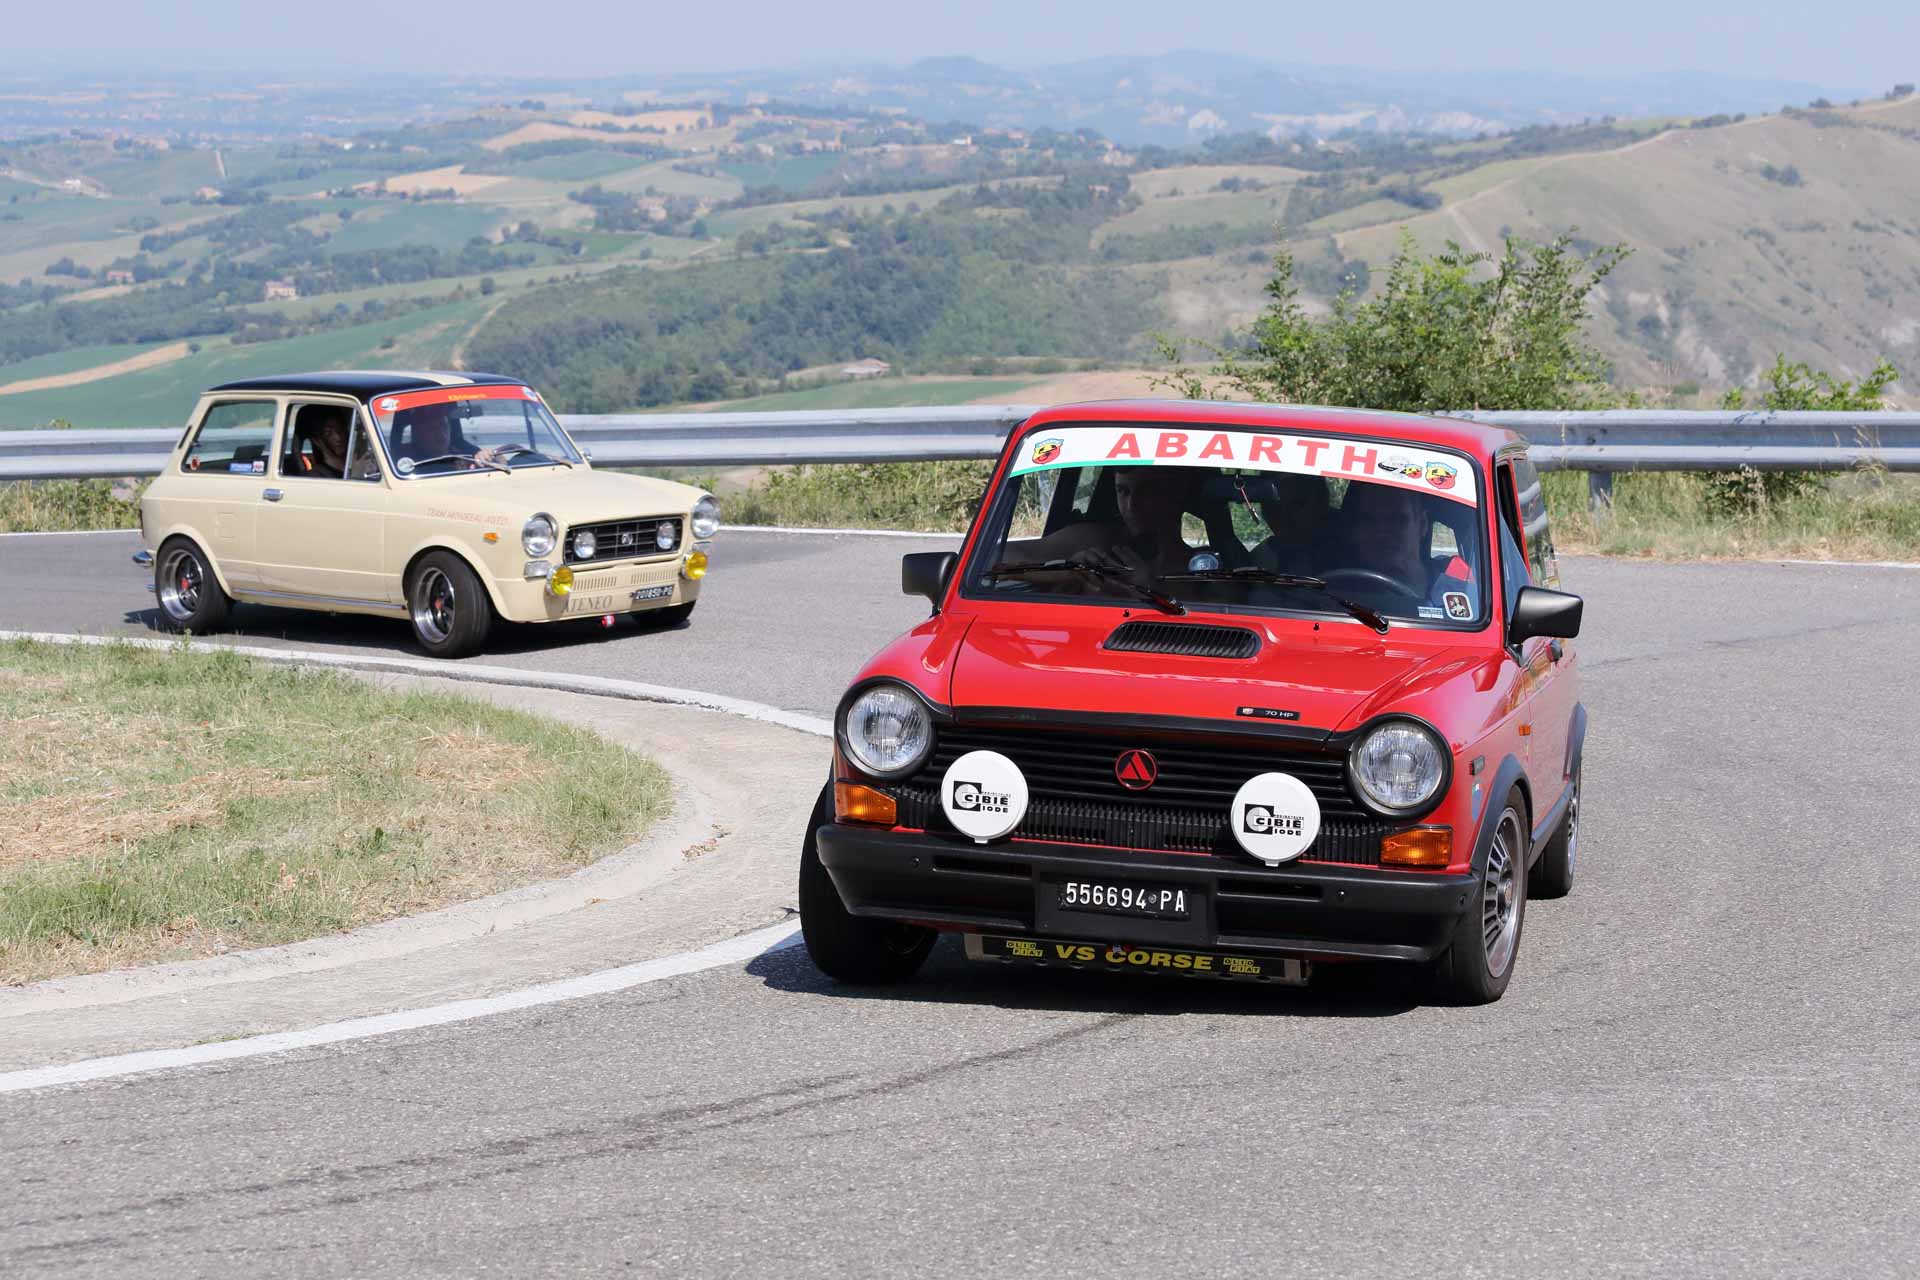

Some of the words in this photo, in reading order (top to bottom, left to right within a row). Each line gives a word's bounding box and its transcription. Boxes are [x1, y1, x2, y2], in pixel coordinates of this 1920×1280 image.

[1105, 432, 1378, 475] ABARTH
[561, 595, 613, 613] ATENEO
[982, 805, 1009, 813] IODE
[1066, 882, 1147, 910] 556694
[1159, 889, 1185, 912] PA
[1055, 944, 1096, 961] VS
[1105, 950, 1214, 970] CORSE
